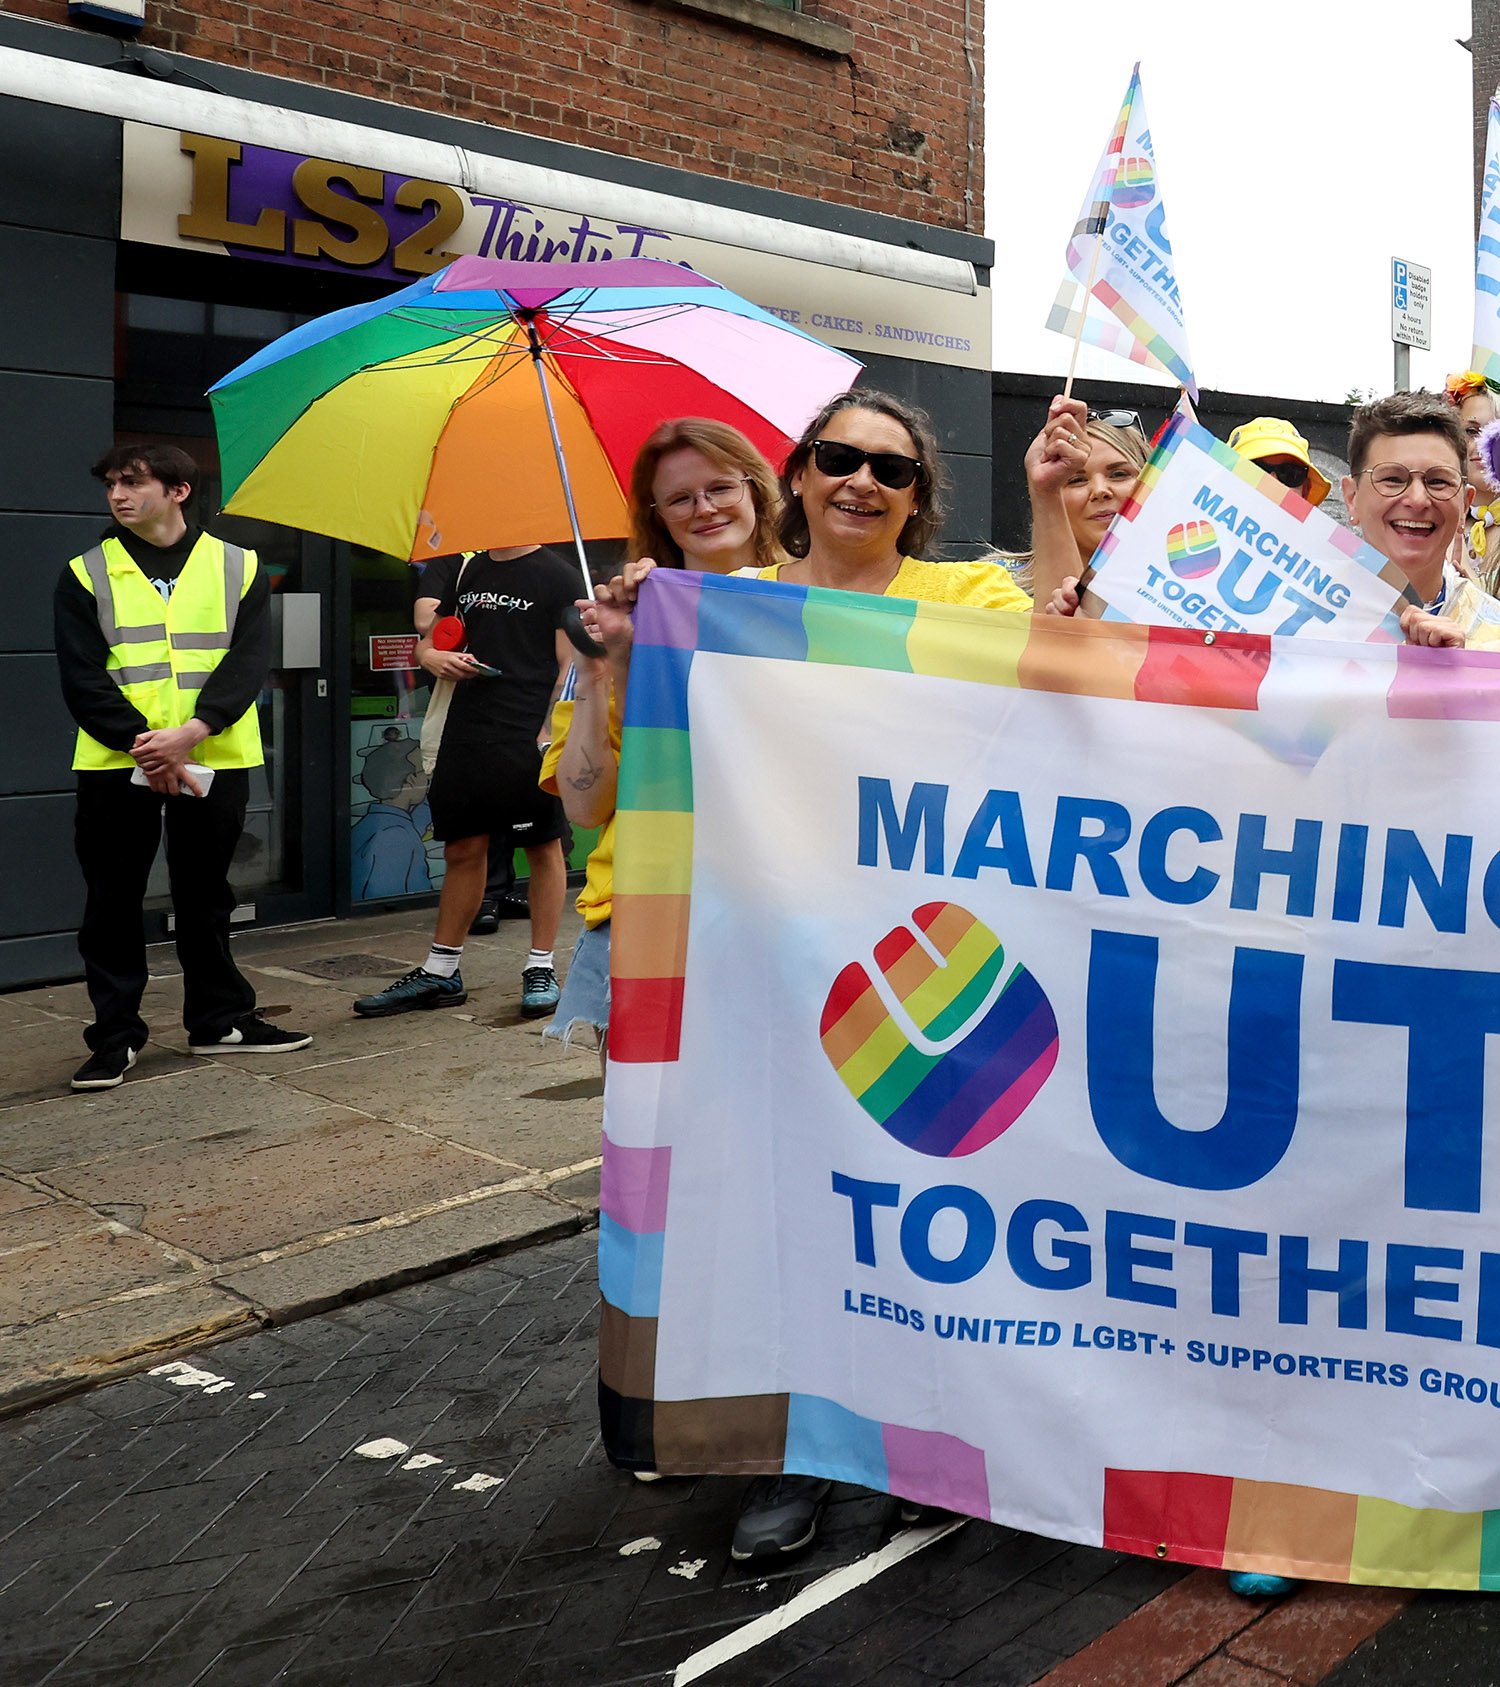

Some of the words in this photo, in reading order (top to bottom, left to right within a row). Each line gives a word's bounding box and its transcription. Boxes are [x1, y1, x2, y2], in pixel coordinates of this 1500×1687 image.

[178, 132, 463, 276] LS2
[1409, 271, 1429, 284] Disabled
[1129, 268, 1167, 307] SUPPORTERS
[1412, 282, 1426, 292] badge
[1410, 290, 1428, 302] holders
[1413, 300, 1424, 310] only
[1407, 314, 1421, 324] hours
[811, 314, 863, 333] CAKES
[875, 324, 971, 351] SANDWICHES
[1400, 323, 1407, 331] No
[1409, 325, 1424, 336] return
[1396, 332, 1411, 342] within
[1416, 336, 1427, 345] hour
[1193, 485, 1351, 609] MARCHING
[459, 592, 534, 611] GIVENCHY
[1157, 602, 1182, 623] UNITED
[844, 1289, 925, 1332] LEEDS
[934, 1315, 1061, 1347] UNITED
[1072, 1323, 1175, 1355] LGBT+
[1187, 1340, 1409, 1387] SUPPORTERS
